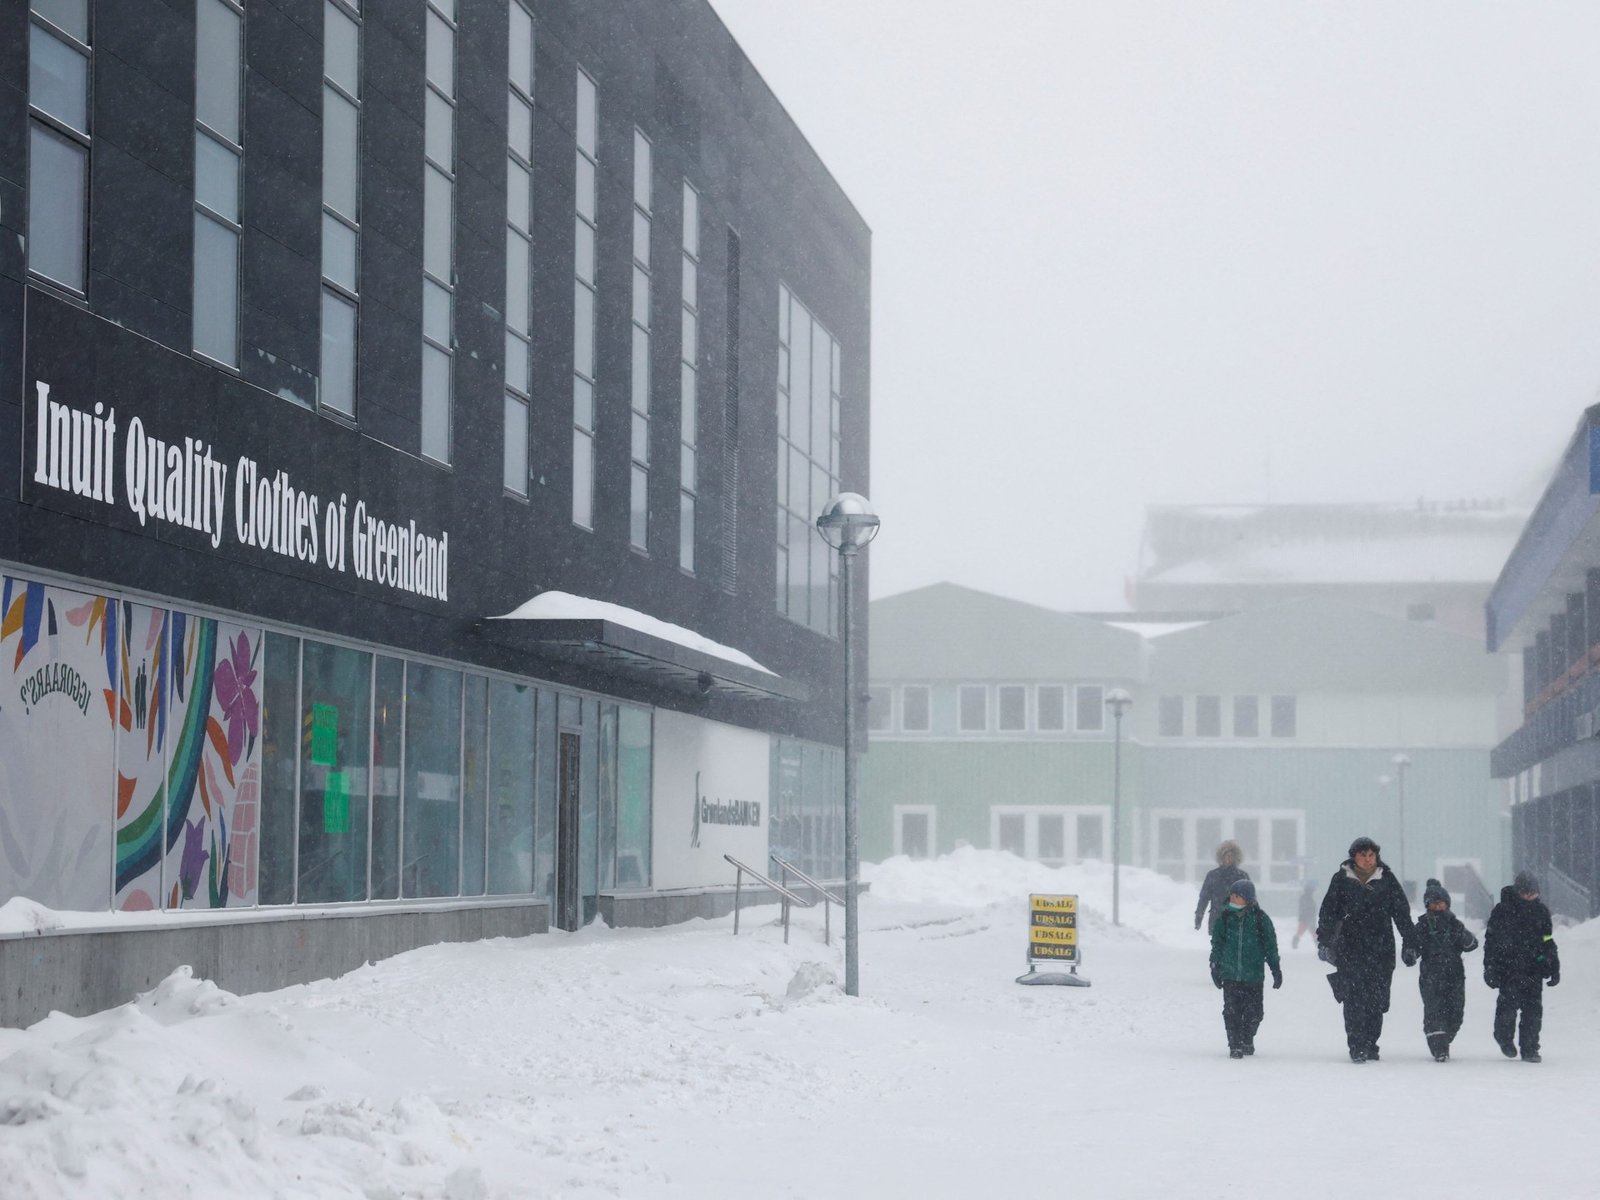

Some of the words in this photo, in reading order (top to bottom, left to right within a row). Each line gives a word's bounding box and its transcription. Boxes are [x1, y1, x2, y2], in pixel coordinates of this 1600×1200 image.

[34, 380, 116, 505] Inuit
[125, 416, 228, 549] Quality
[235, 455, 319, 565] Clothes
[325, 492, 347, 573] of
[352, 499, 449, 602] Greenland
[1035, 899, 1073, 909] UDSALG
[1035, 914, 1073, 925] UDSALG
[1034, 930, 1072, 940] UDSALG
[1034, 946, 1072, 956] UDSALG
